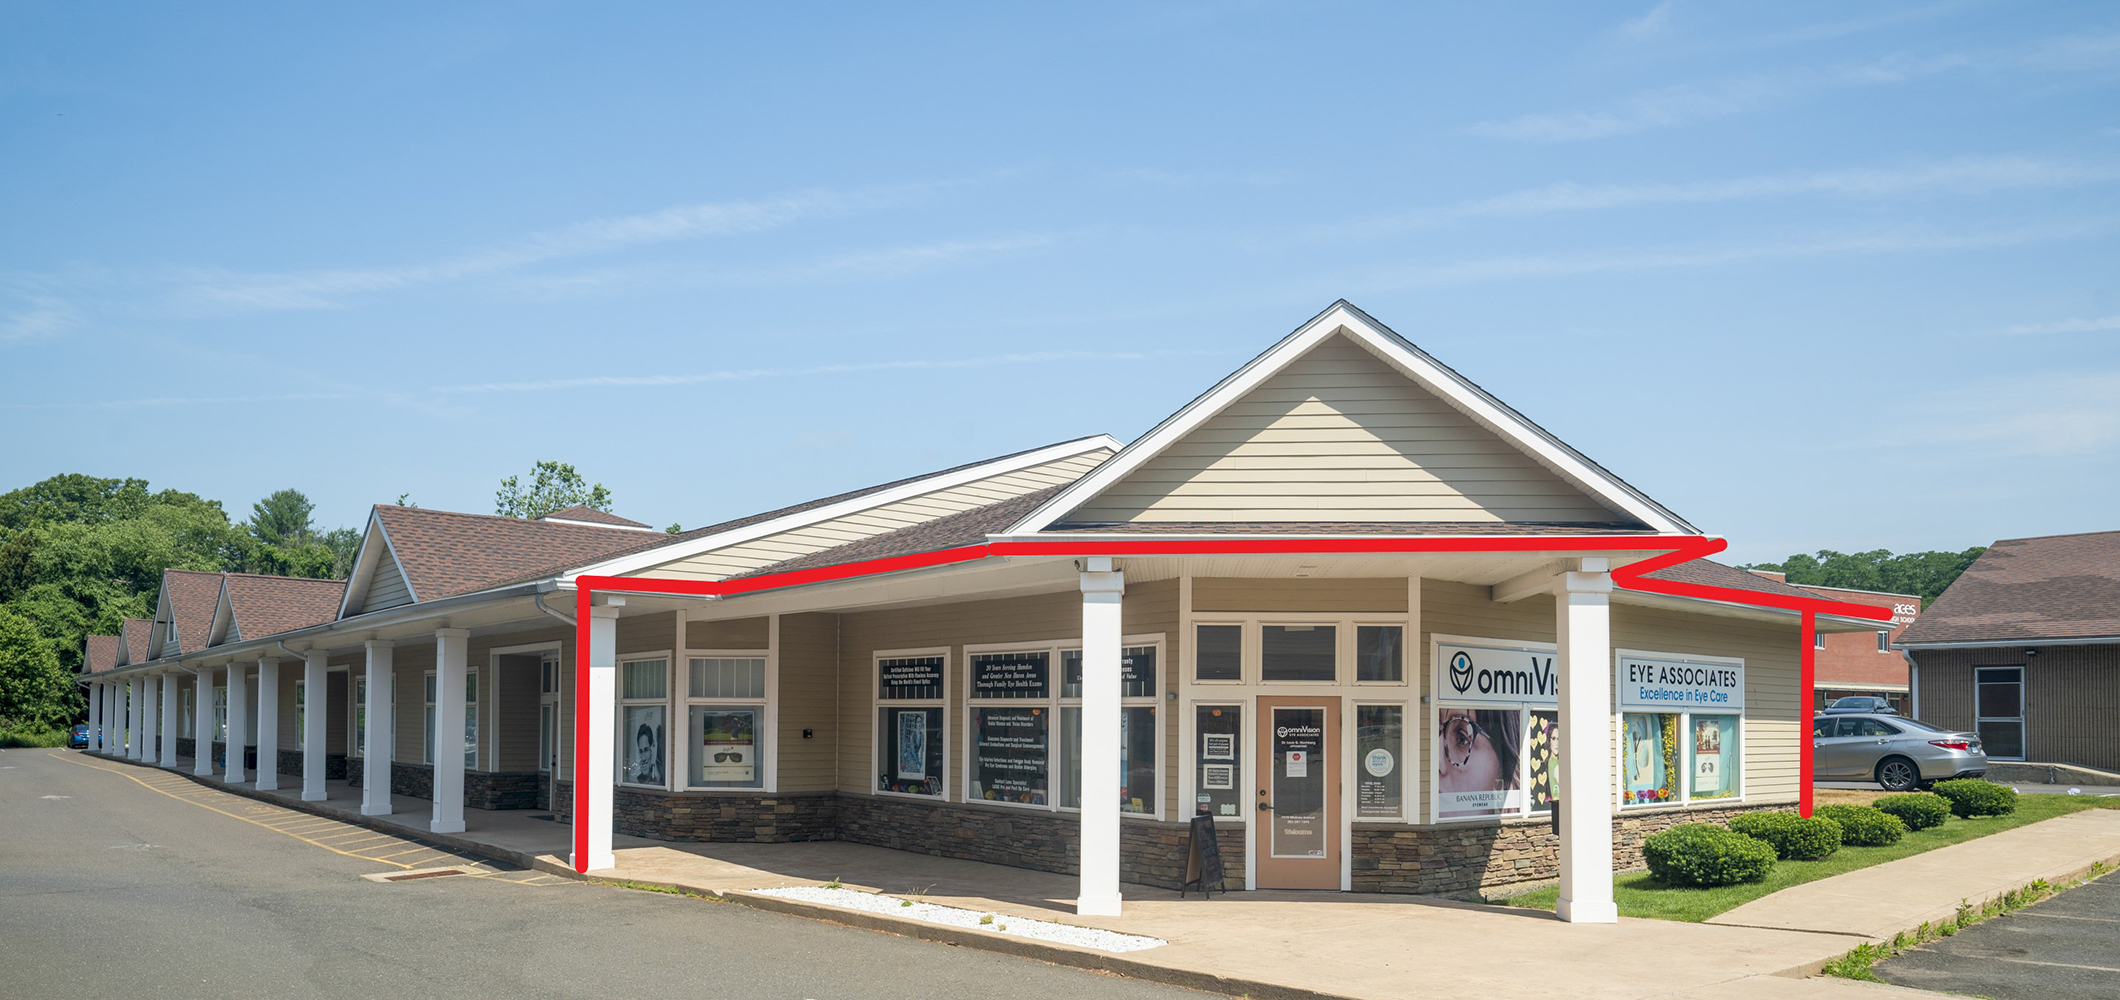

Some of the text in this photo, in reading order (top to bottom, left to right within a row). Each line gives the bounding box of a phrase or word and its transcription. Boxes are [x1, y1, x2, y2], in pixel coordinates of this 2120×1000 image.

[1894, 603, 1916, 615] aces
[1630, 664, 1736, 688] EYE ASSOCIATES
[1640, 686, 1728, 704] Excellence in Eye Care
[1456, 793, 1502, 802] BANANA REPUBLIC
